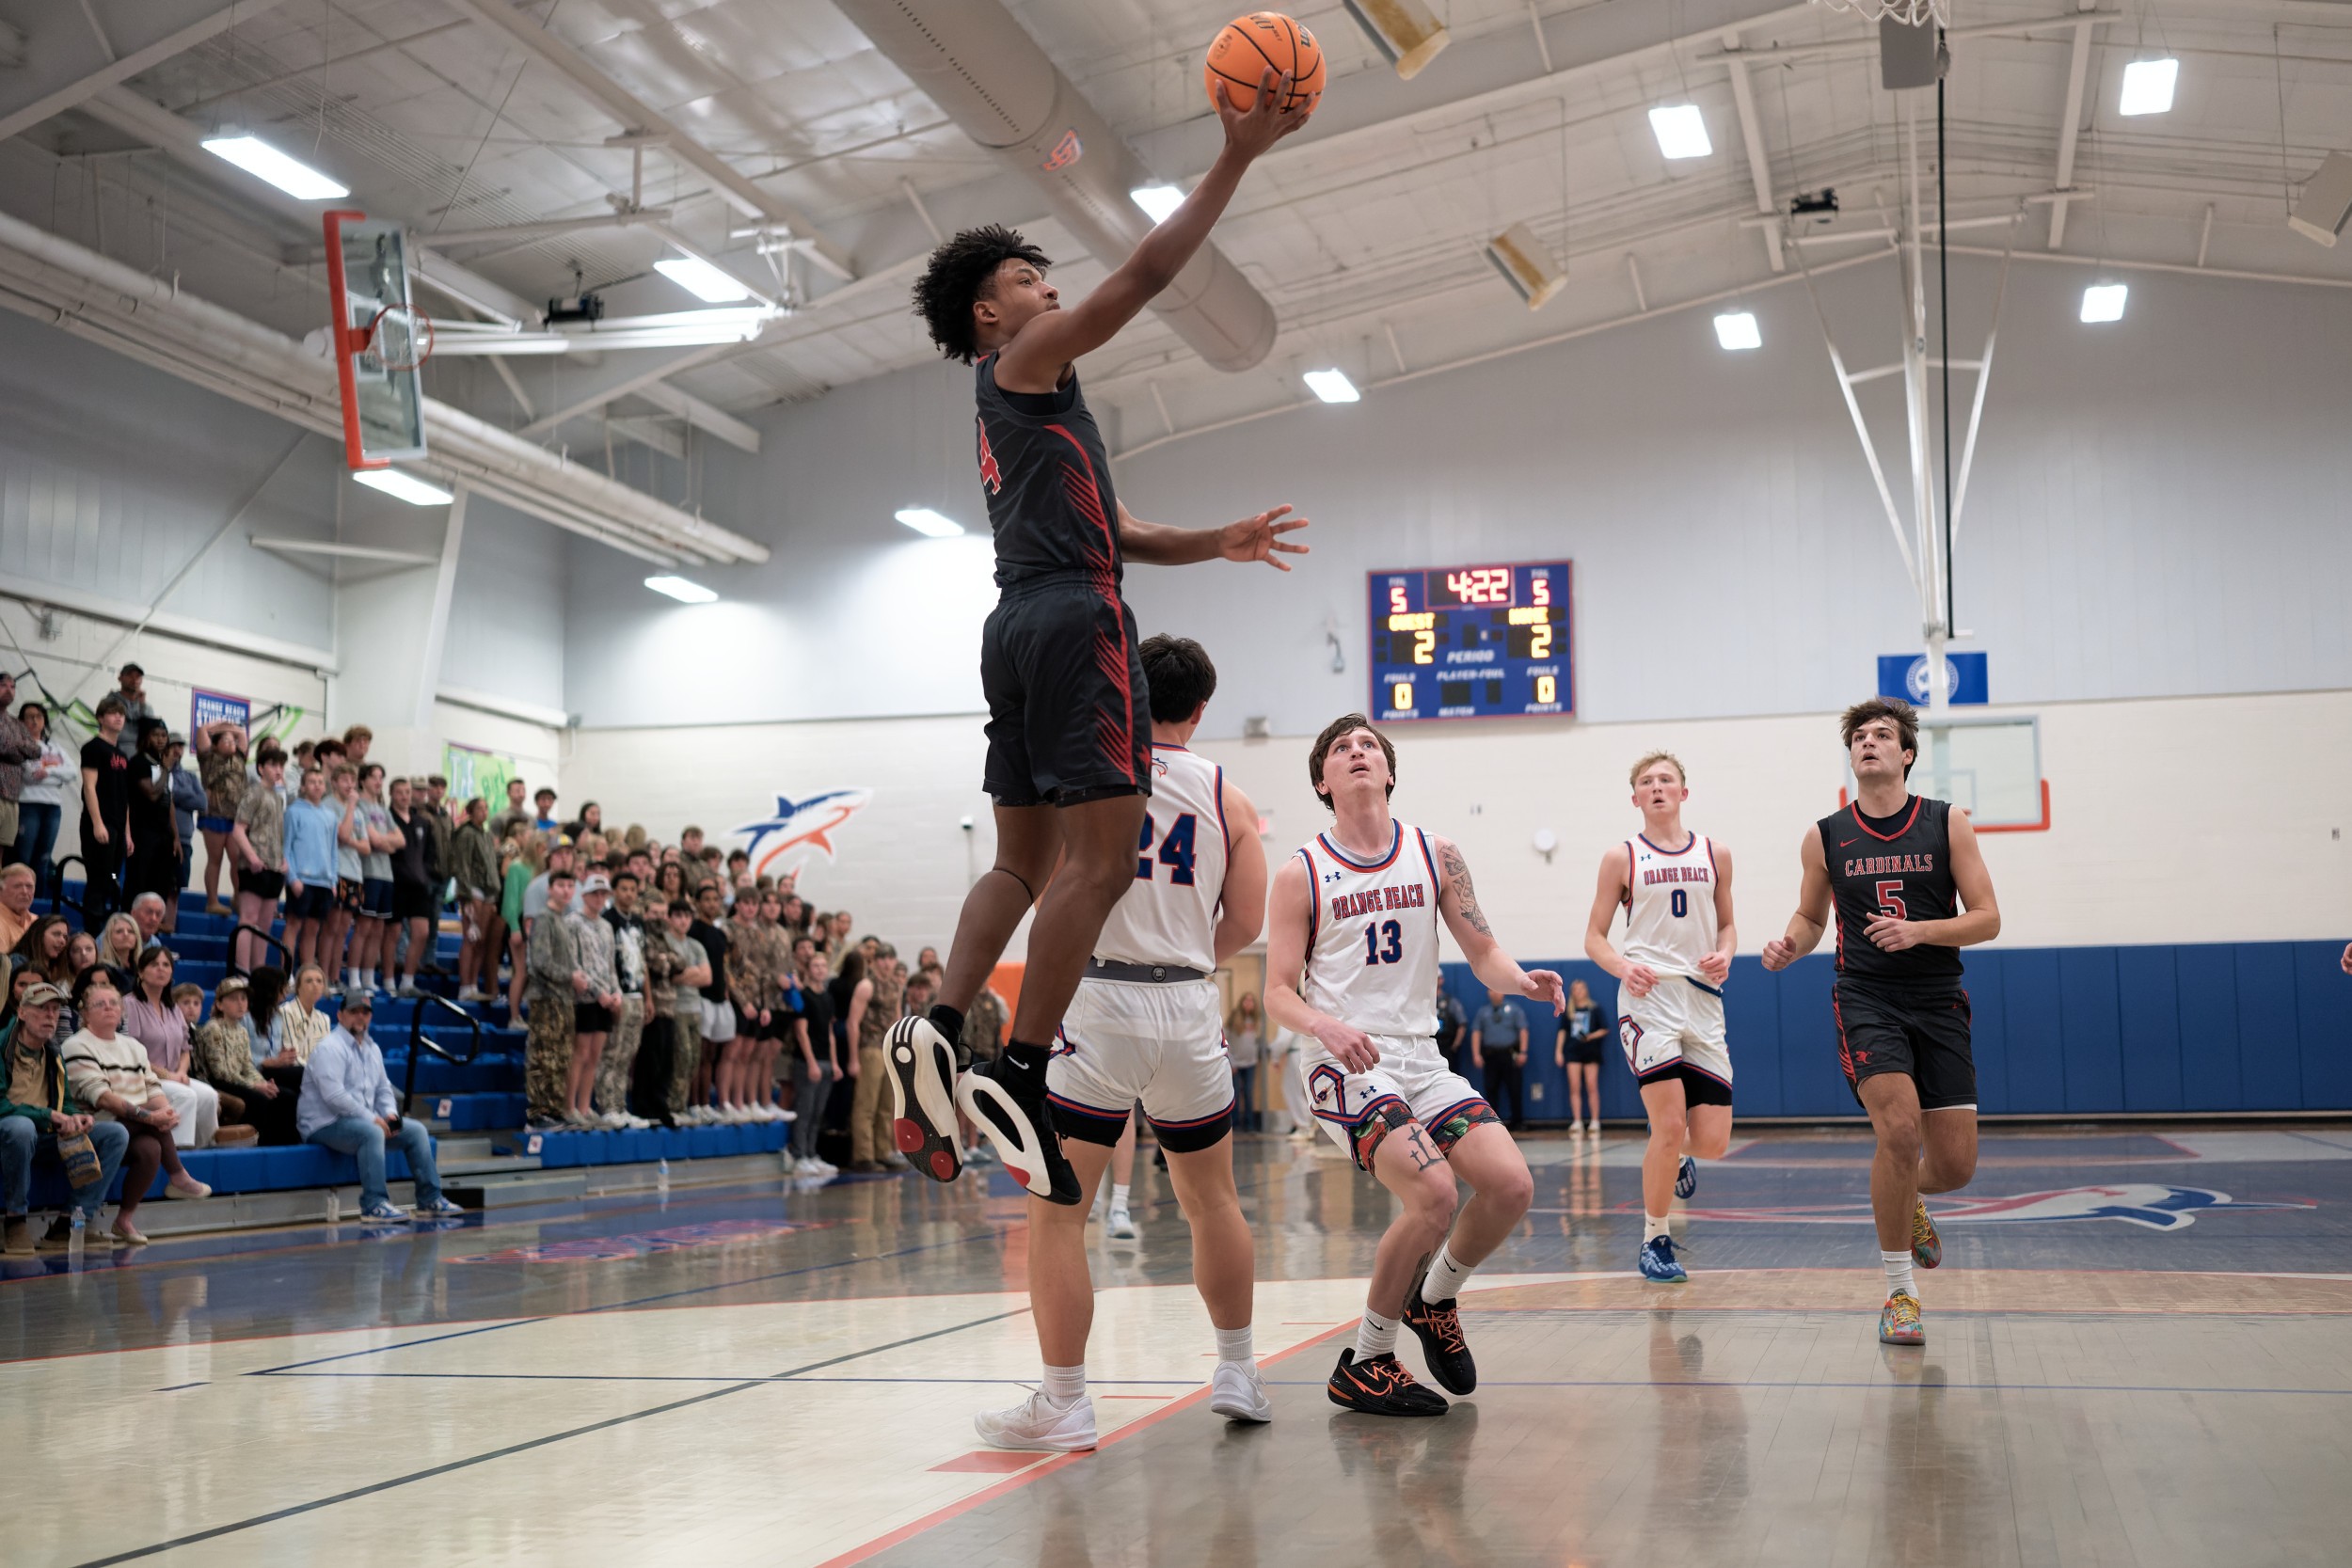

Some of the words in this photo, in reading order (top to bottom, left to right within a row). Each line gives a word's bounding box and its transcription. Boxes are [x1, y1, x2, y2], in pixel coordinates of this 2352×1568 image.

[1390, 587, 1407, 612] 5
[1447, 568, 1509, 603] 4:22
[1532, 579, 1550, 605] 5
[1414, 630, 1436, 664] 2
[1531, 625, 1551, 658] 2
[1447, 650, 1495, 664] PERIOD
[1394, 683, 1413, 710] 0
[1537, 675, 1555, 704] 0
[1644, 867, 1679, 886] ORANGE
[1680, 866, 1708, 883] BEACH
[1845, 854, 1933, 877] CARDINALS
[1332, 889, 1384, 920] ORANGE
[1383, 883, 1425, 911] BEACH
[1671, 889, 1688, 918] 0
[1875, 879, 1908, 921] 5
[1364, 919, 1403, 966] 13
